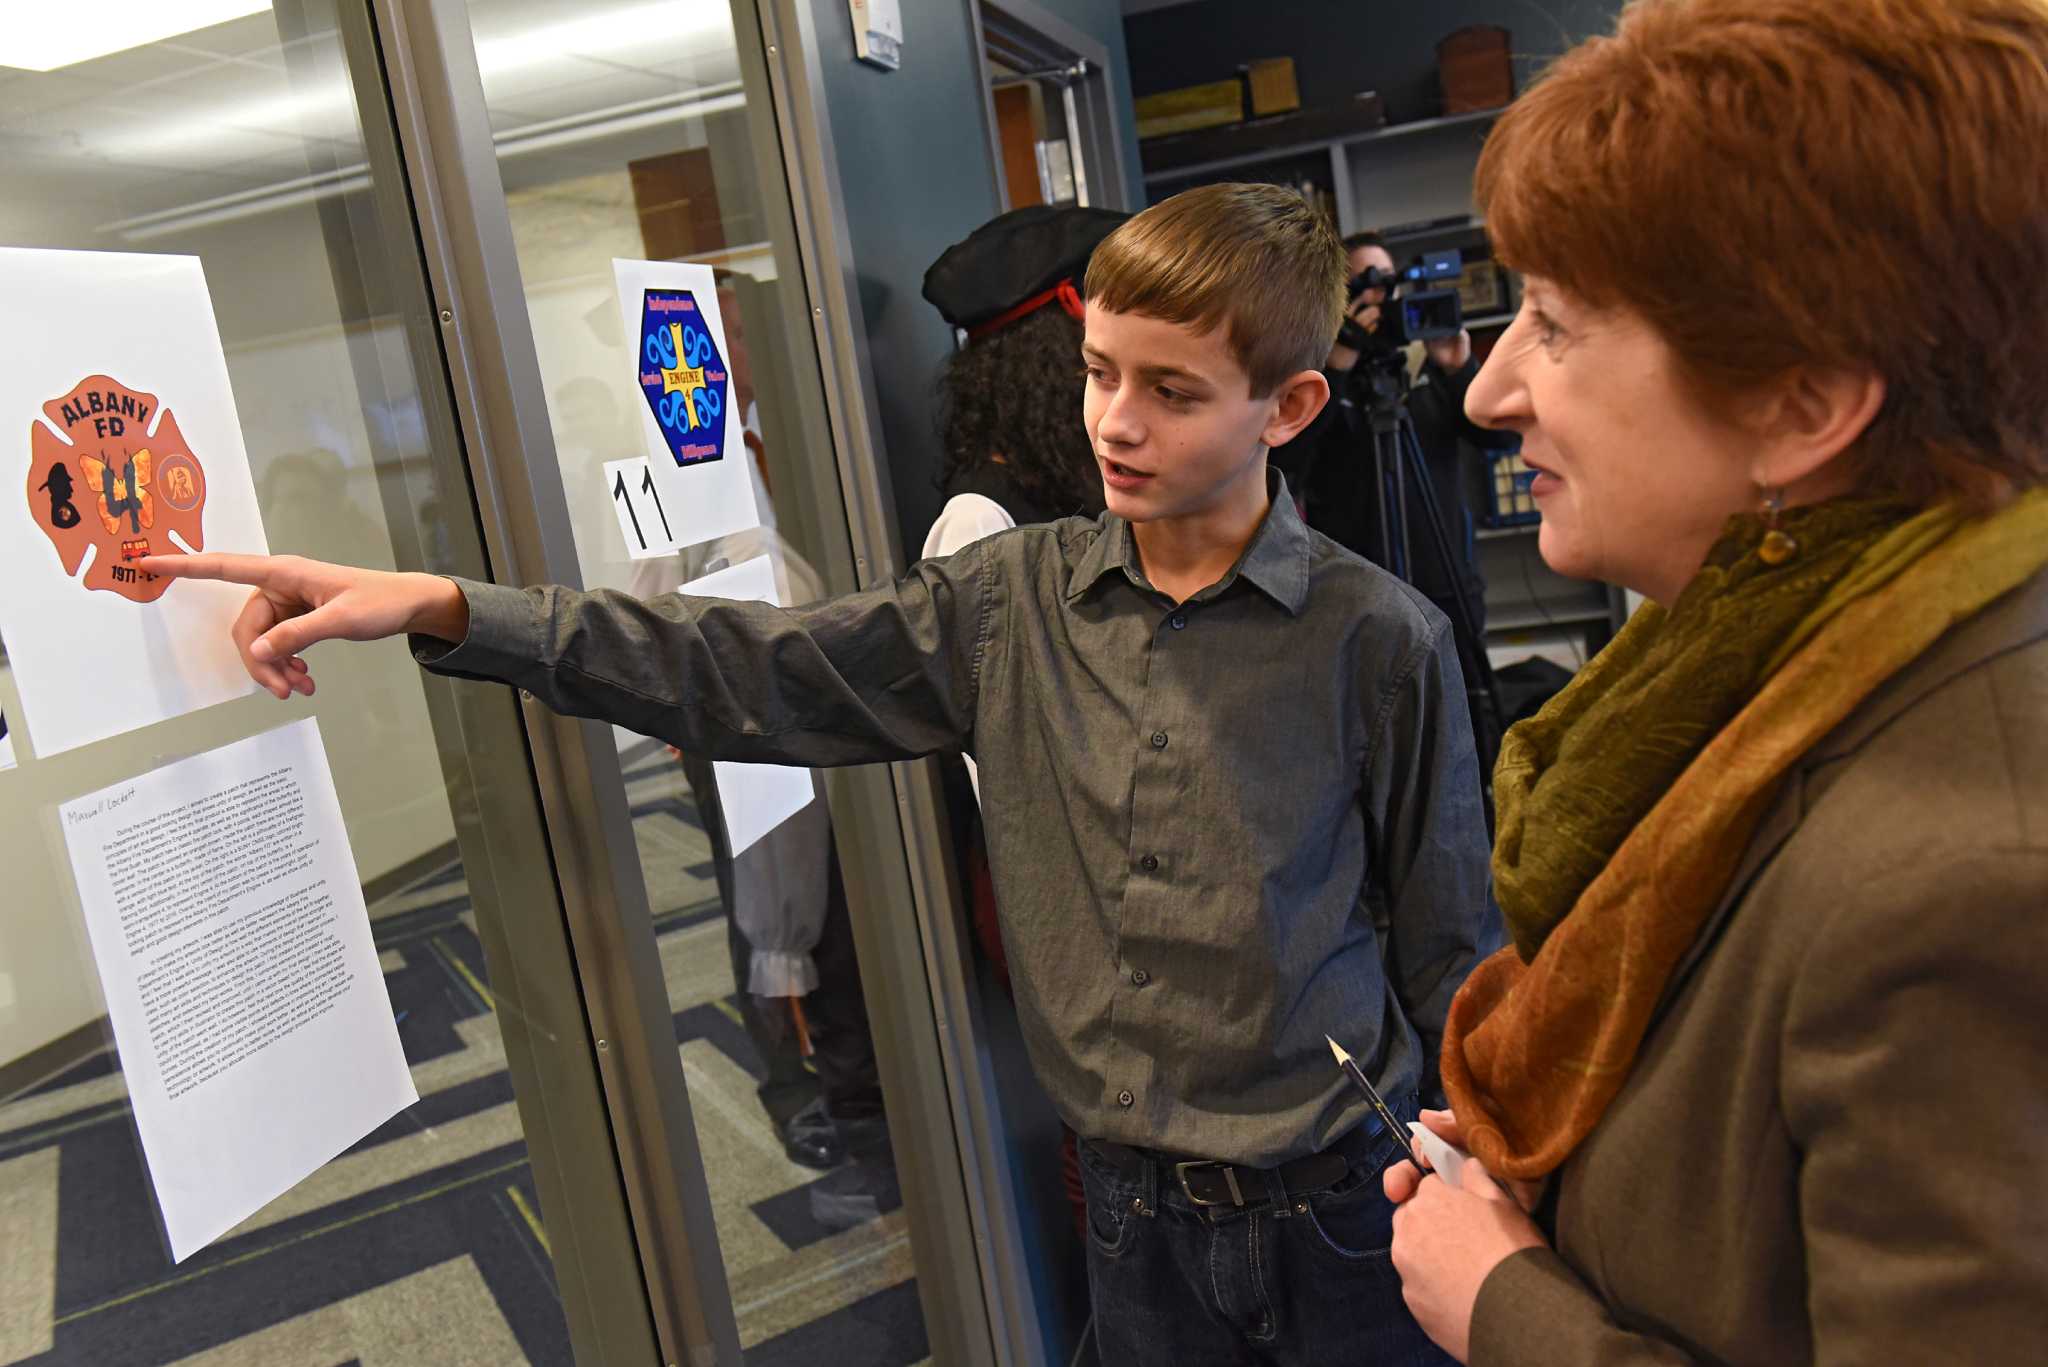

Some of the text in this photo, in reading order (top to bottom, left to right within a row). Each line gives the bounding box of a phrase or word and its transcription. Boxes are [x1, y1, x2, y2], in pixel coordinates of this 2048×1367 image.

[668, 371, 701, 384] ENGINE
[685, 388, 691, 400] 4
[61, 391, 148, 427] ALBANY
[94, 416, 125, 438] FD
[102, 453, 143, 533] 4
[614, 466, 672, 550] 11
[111, 565, 136, 583] 1977
